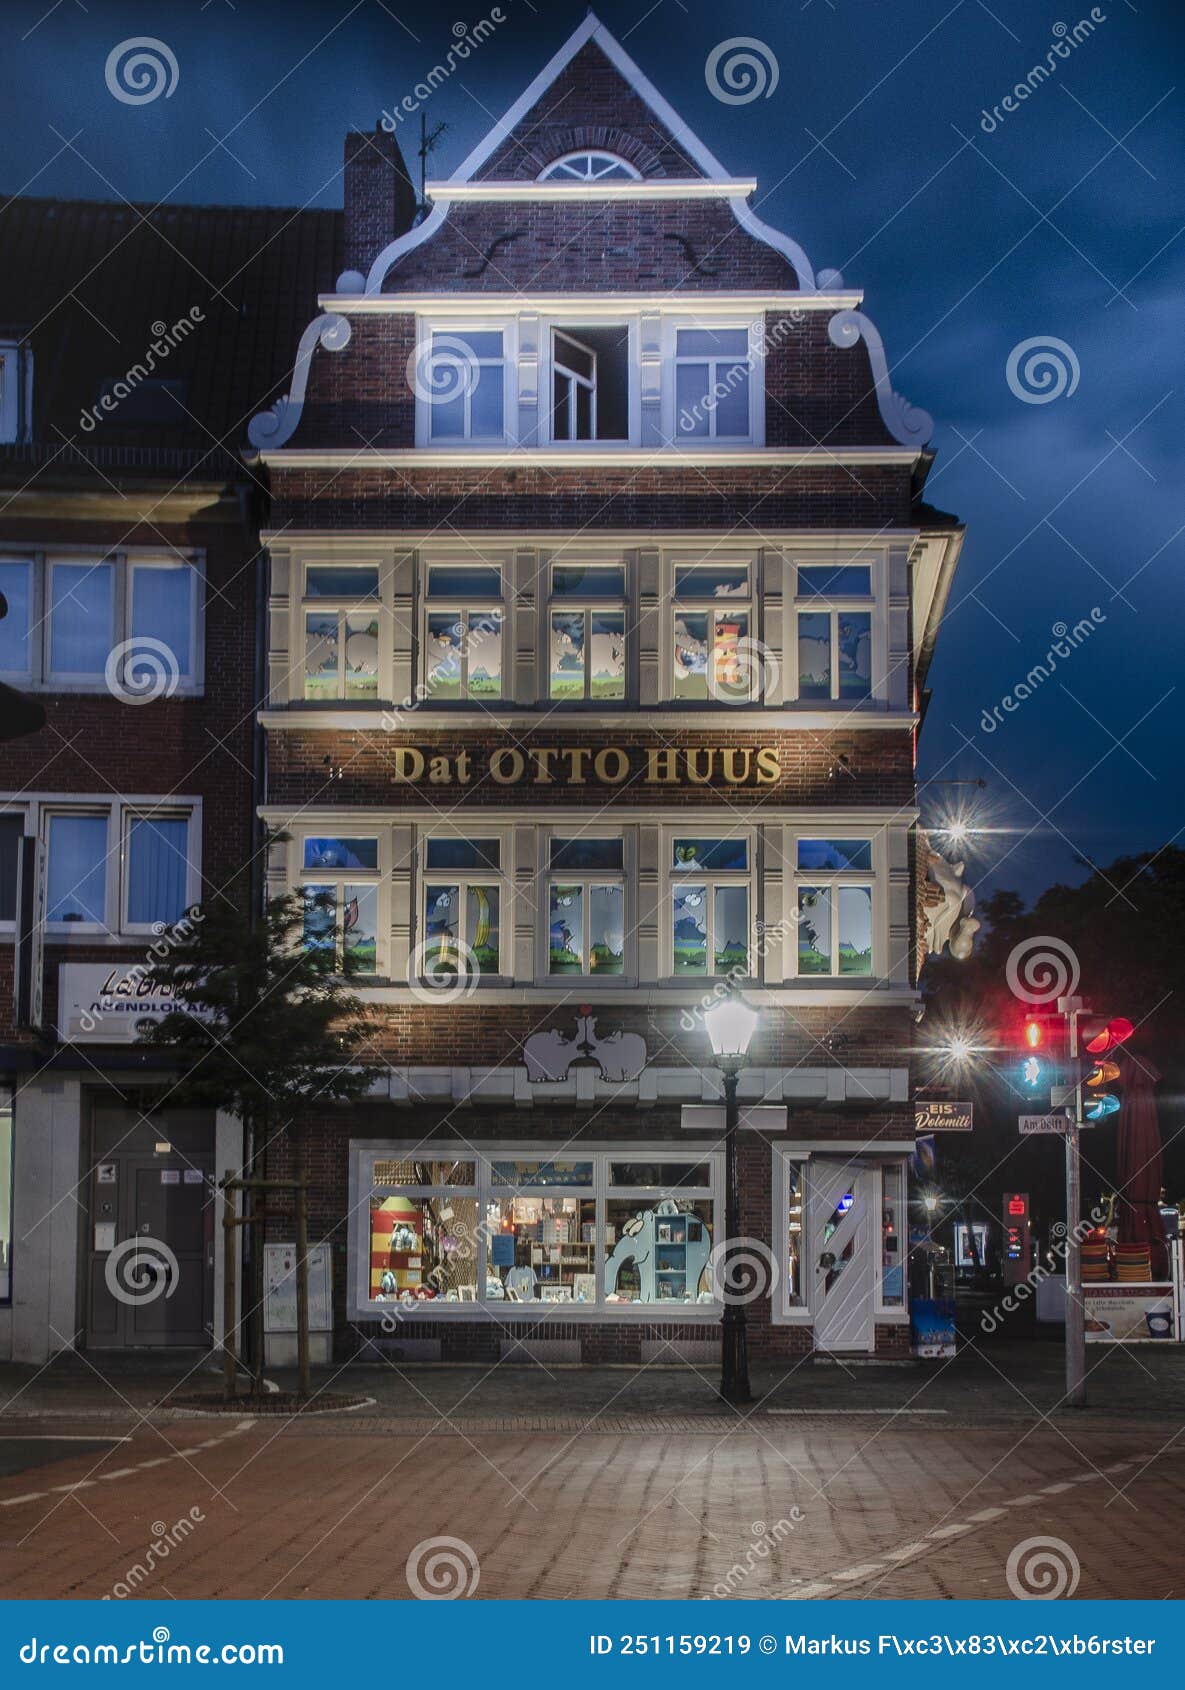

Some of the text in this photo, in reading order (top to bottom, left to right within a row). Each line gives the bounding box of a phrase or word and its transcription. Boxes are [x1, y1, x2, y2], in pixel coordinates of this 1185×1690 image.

[391, 747, 782, 784] Dat OTTO HUUS
[915, 1114, 970, 1129] Dolomiti
[1023, 1119, 1037, 1130] Am
